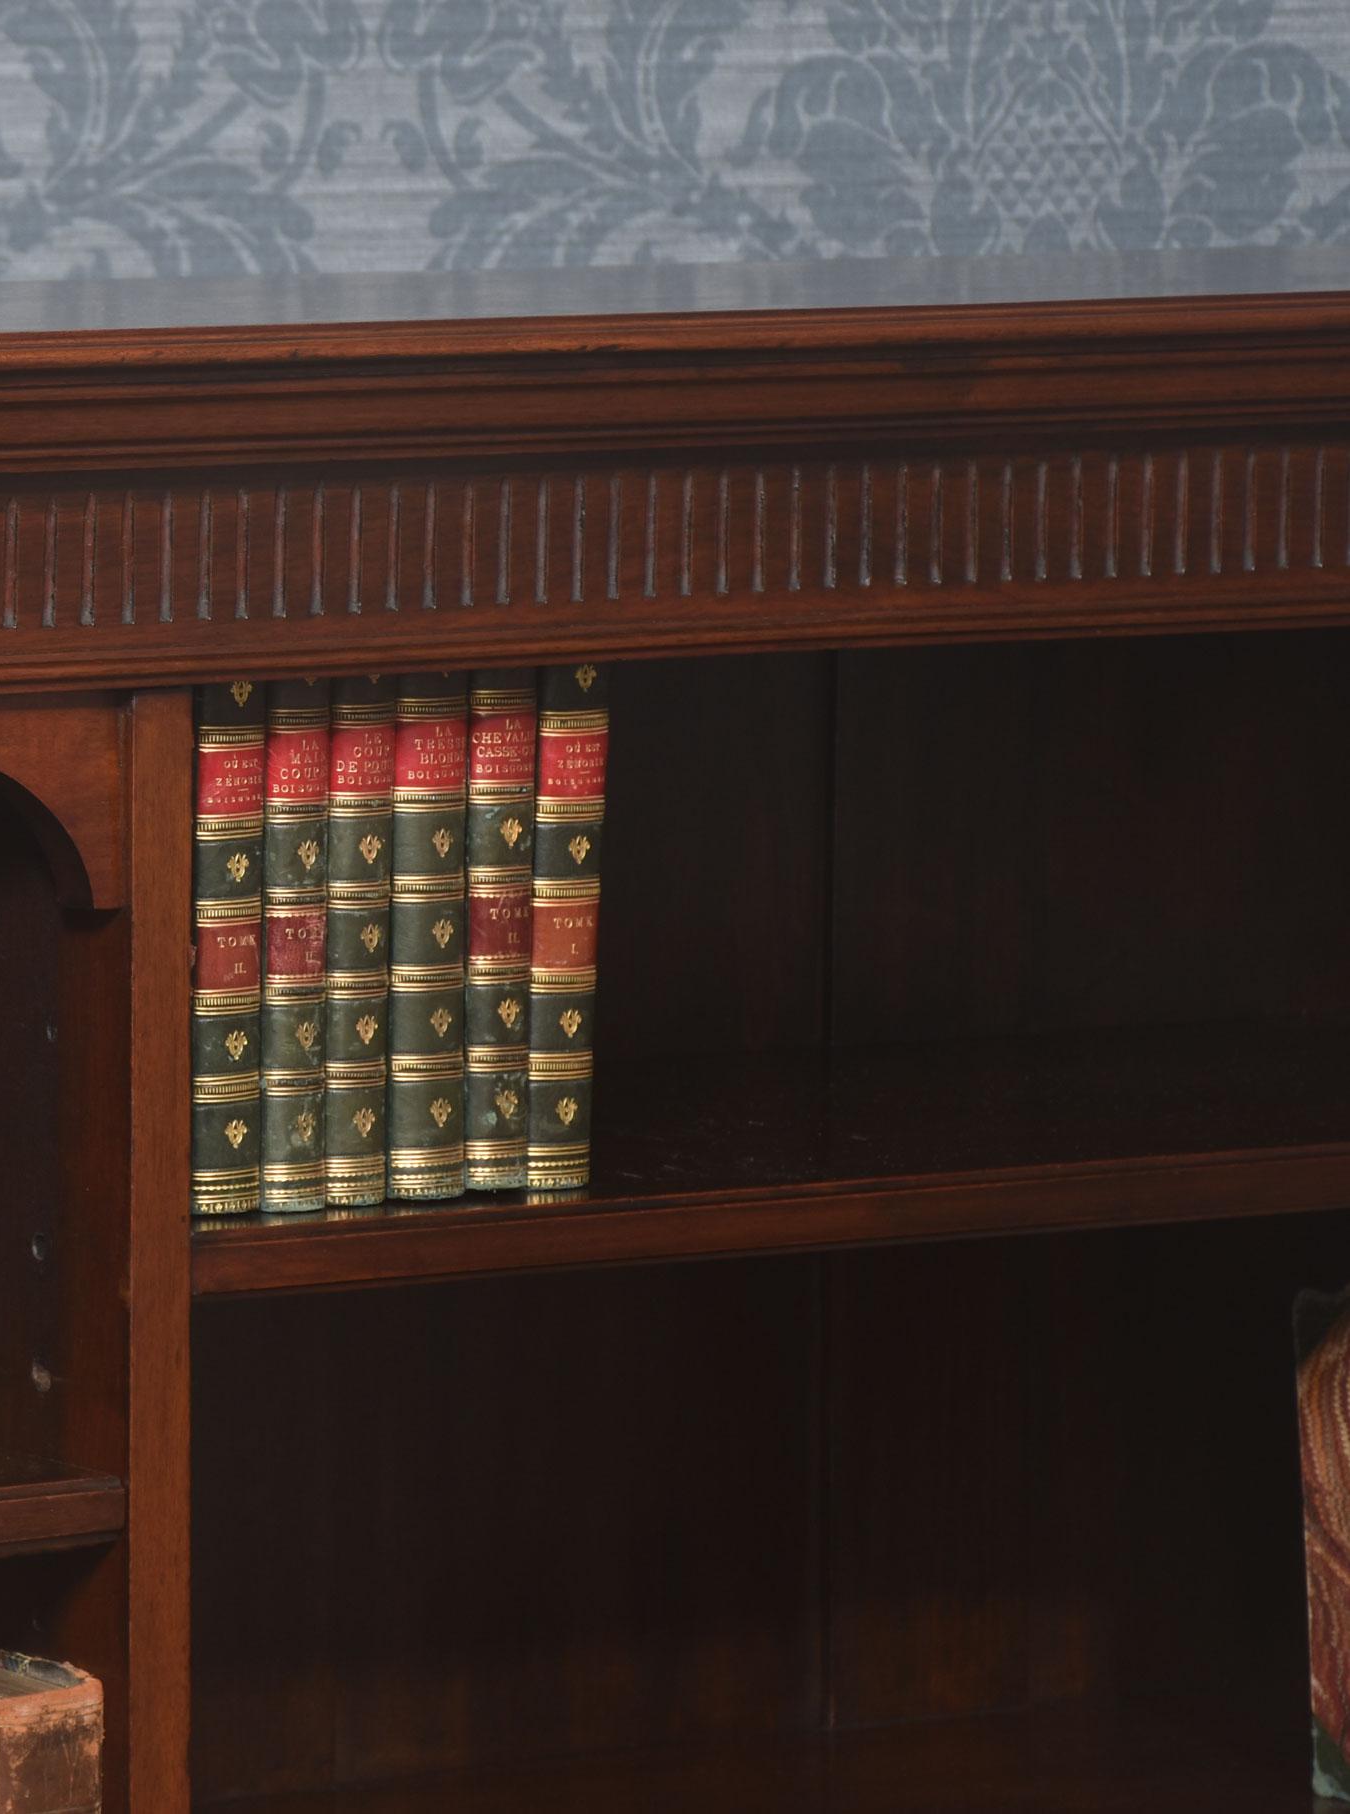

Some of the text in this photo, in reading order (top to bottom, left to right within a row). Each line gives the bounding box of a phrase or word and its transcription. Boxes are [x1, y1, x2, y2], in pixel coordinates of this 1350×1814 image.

[505, 719, 522, 730] LA
[436, 726, 453, 737] LA
[302, 739, 319, 751] LA
[336, 760, 358, 773] DE
